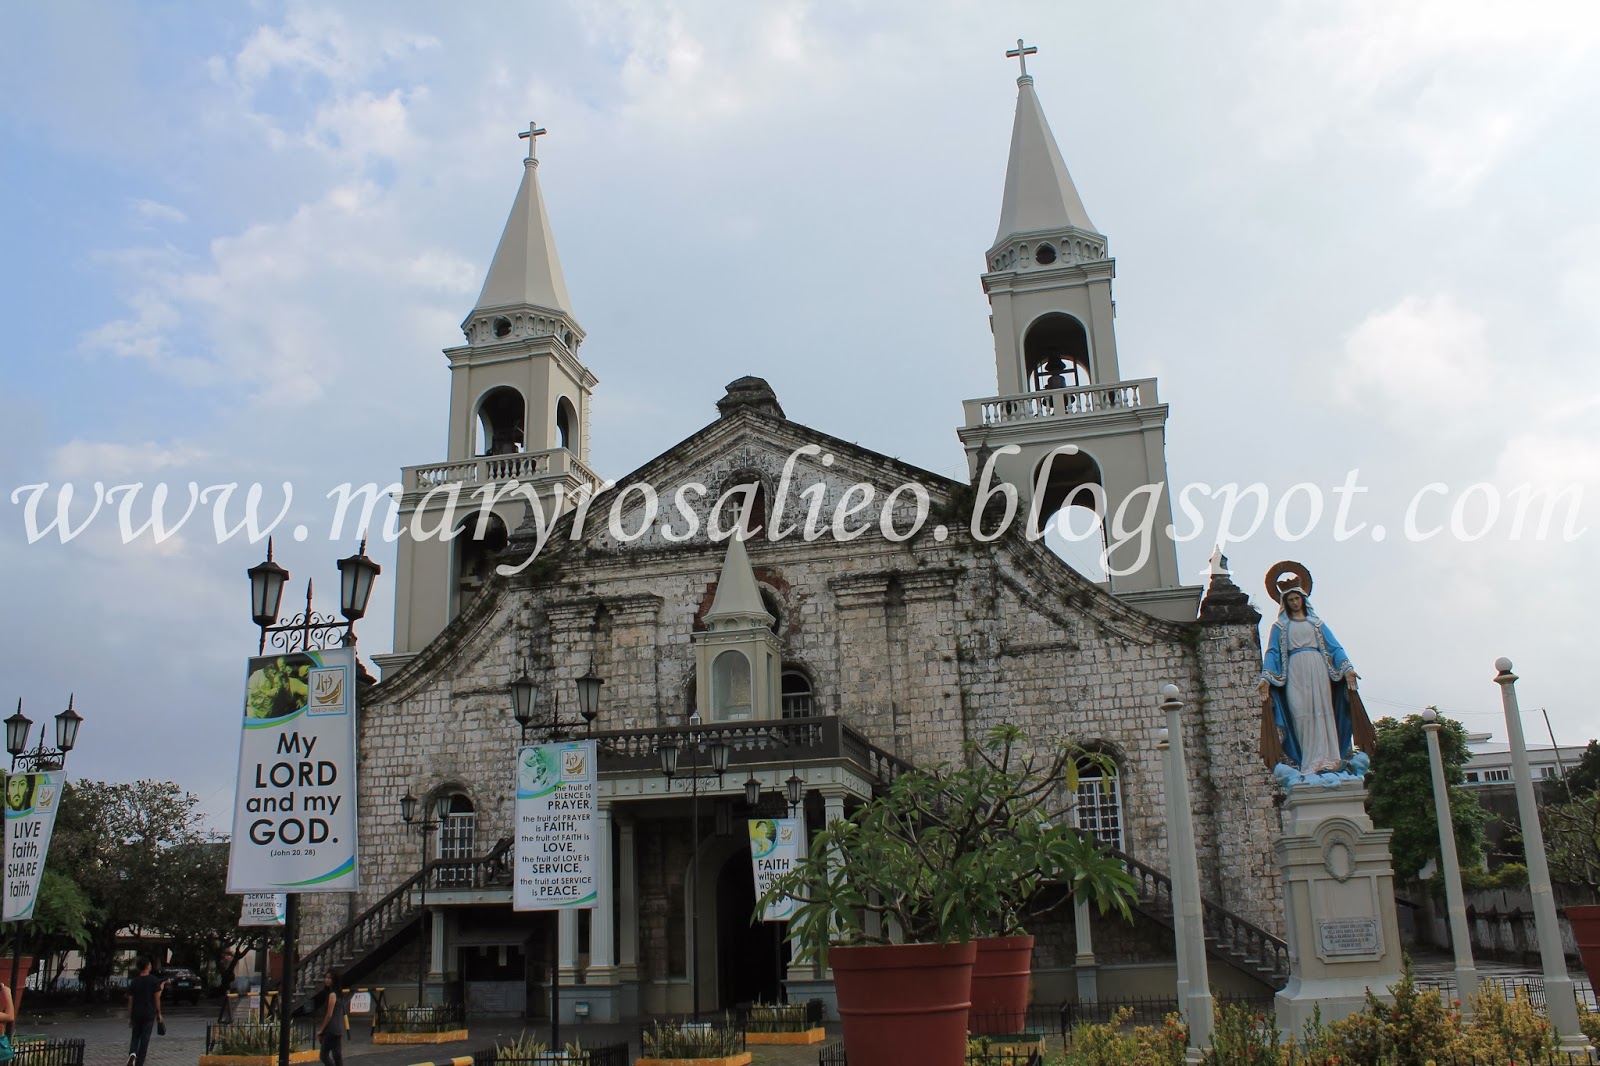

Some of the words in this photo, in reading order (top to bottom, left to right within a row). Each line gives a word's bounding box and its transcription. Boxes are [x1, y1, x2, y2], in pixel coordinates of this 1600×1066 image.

[277, 731, 318, 758] My
[255, 760, 338, 788] LORD
[246, 791, 294, 812] and
[304, 795, 341, 815] my
[548, 800, 592, 810] PRAYER,
[537, 814, 551, 822] fruit
[562, 813, 591, 821] PRAYER
[14, 821, 41, 838] LIVE
[249, 818, 338, 846] GOD.
[544, 821, 577, 832] FAITH,
[561, 833, 582, 841] FAITH
[12, 841, 39, 859] faith,
[270, 849, 290, 857] (John
[304, 849, 316, 857] 28)
[543, 842, 576, 853] LOVE,
[562, 854, 582, 862] LOVE
[758, 858, 789, 870] FAITH
[8, 861, 37, 878] SHARE
[532, 862, 582, 874] SERVICE,
[534, 877, 549, 885] fruit
[561, 876, 592, 885] SERVICE
[9, 880, 31, 897] faith.
[540, 885, 580, 896] PEACE.
